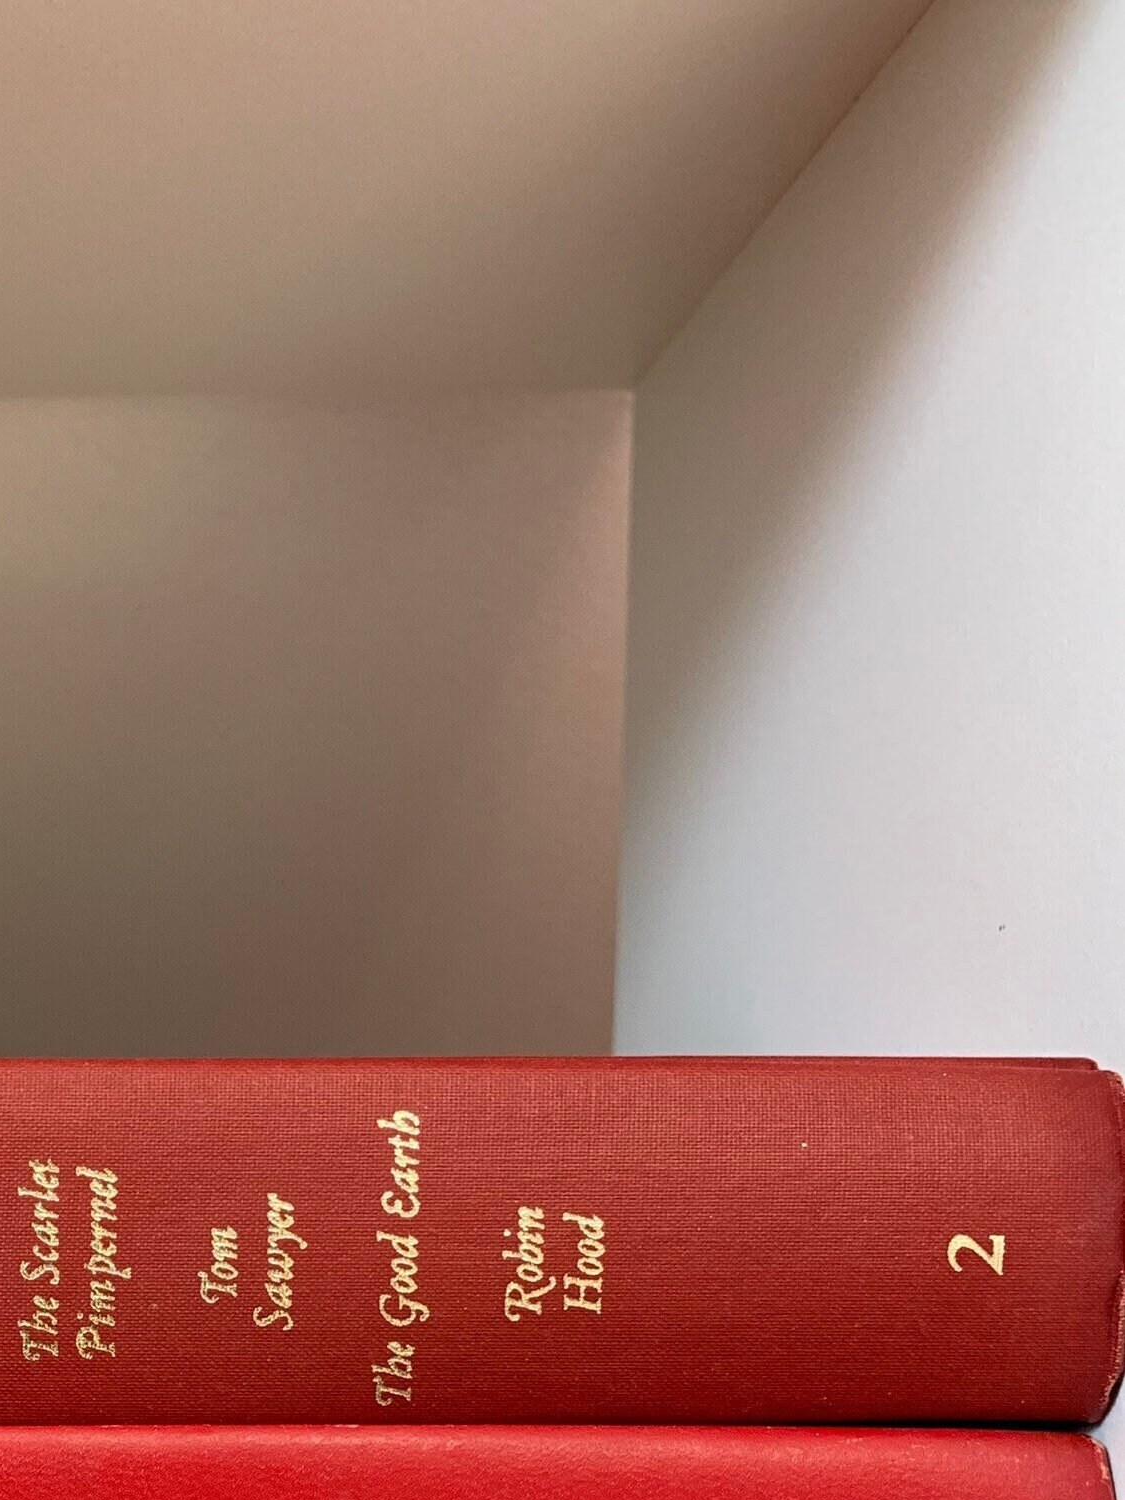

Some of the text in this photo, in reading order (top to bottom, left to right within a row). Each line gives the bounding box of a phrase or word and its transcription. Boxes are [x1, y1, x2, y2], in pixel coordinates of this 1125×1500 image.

[17, 1158, 60, 1363] The Scarlet
[76, 1166, 132, 1361] Pimpernel
[200, 1226, 239, 1304] Tom
[253, 1193, 308, 1331] Sawyer
[371, 1109, 430, 1407] The Good Earth
[504, 1205, 556, 1322] Robin
[563, 1213, 605, 1314] Hood
[947, 1234, 1005, 1276] 2
